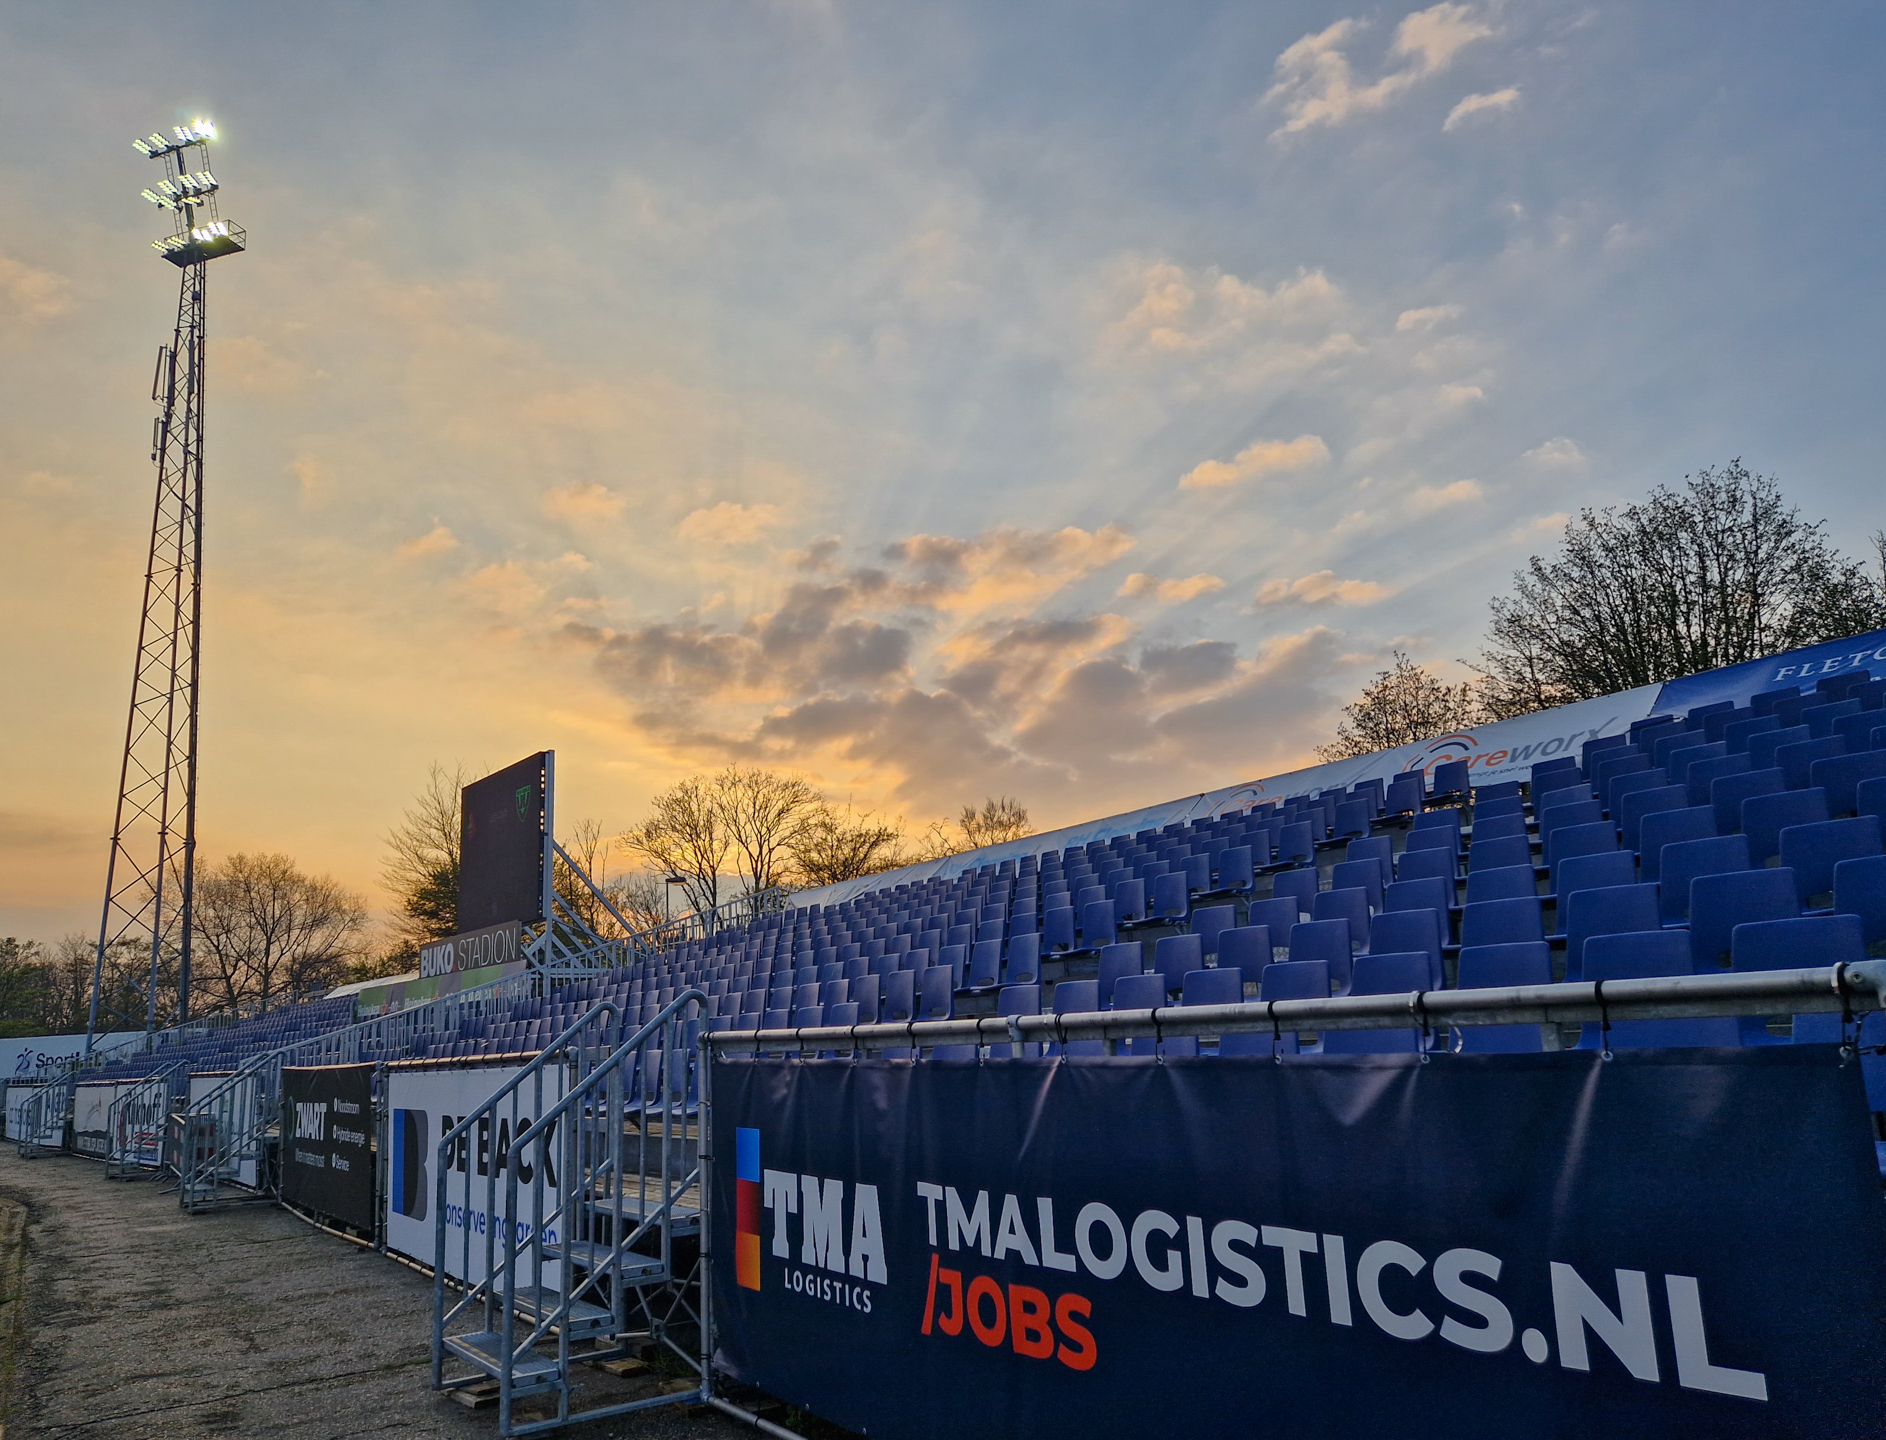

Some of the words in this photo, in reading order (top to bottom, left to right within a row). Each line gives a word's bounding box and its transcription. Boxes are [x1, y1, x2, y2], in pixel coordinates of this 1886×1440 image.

[1424, 716, 1620, 777] Creworx
[457, 927, 517, 971] STADION
[296, 1103, 327, 1140] ZWART
[336, 1155, 350, 1171] Service
[764, 1168, 888, 1285] TMA
[784, 1267, 872, 1314] LOGISTICS
[917, 1181, 1768, 1402] TMALOGISTICS.NL
[921, 1253, 1098, 1371] /JOBS
